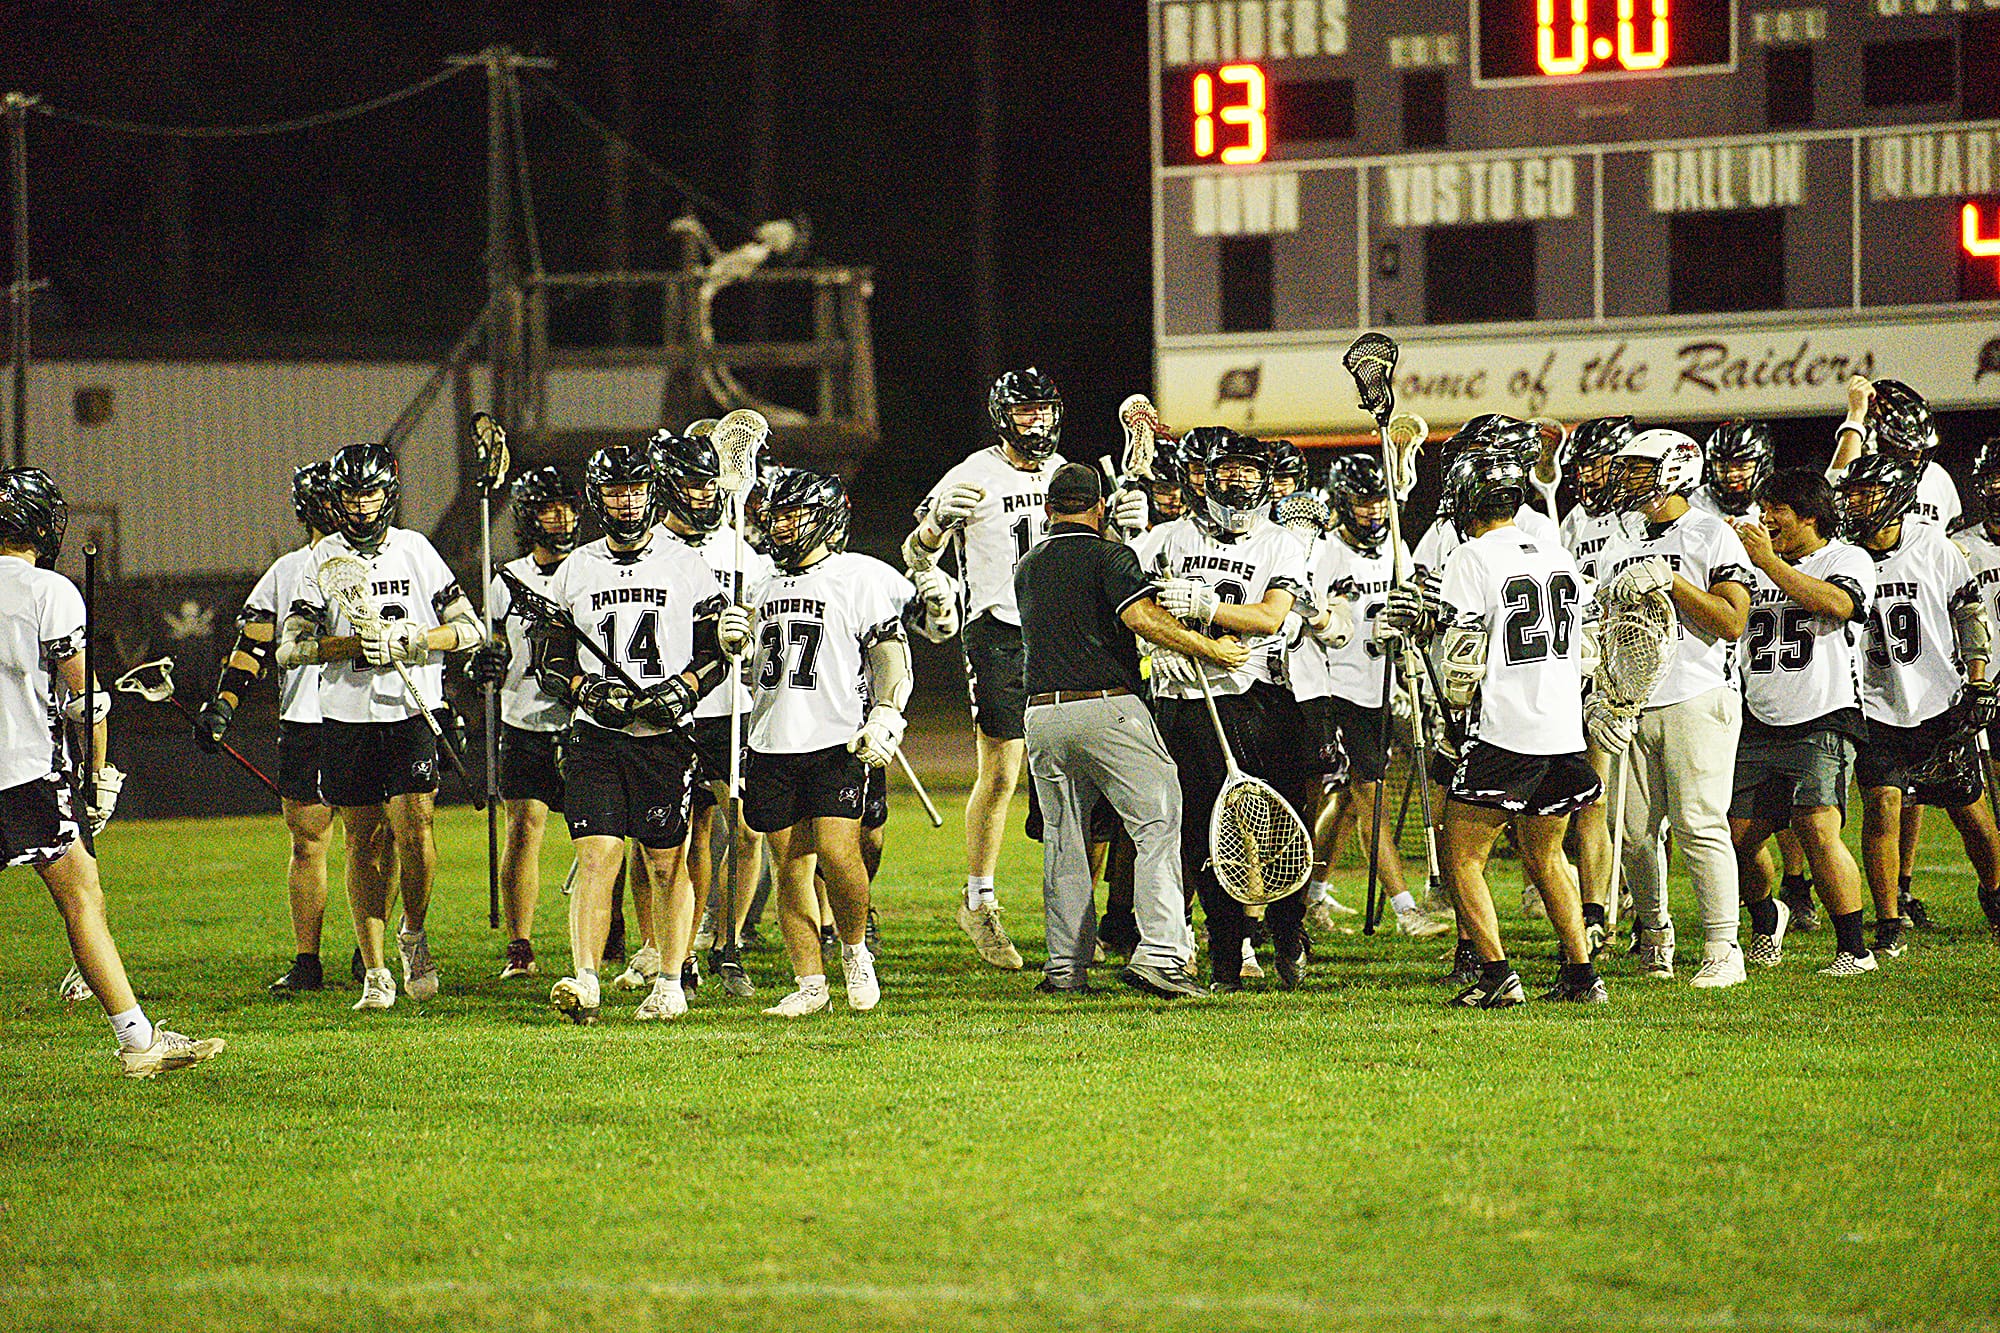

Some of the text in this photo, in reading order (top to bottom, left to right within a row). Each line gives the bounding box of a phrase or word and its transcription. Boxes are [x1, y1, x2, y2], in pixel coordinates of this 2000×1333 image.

[1537, 0, 1668, 75] 0.0
[1194, 64, 1267, 165] 13
[1470, 161, 1517, 222] TO
[1523, 158, 1577, 219] GO
[1652, 143, 1804, 213] BALL ON
[1870, 133, 2000, 200] QUAR
[1394, 338, 1876, 417] ome of the Raiders
[1002, 492, 1049, 513] RAID
[371, 579, 410, 596] DERS
[590, 587, 667, 611] RAIDERS
[1181, 555, 1256, 582] RAIDERS
[596, 610, 665, 680] 14
[1500, 570, 1580, 666] 26
[1746, 607, 1815, 674] 25
[758, 620, 824, 690] 37
